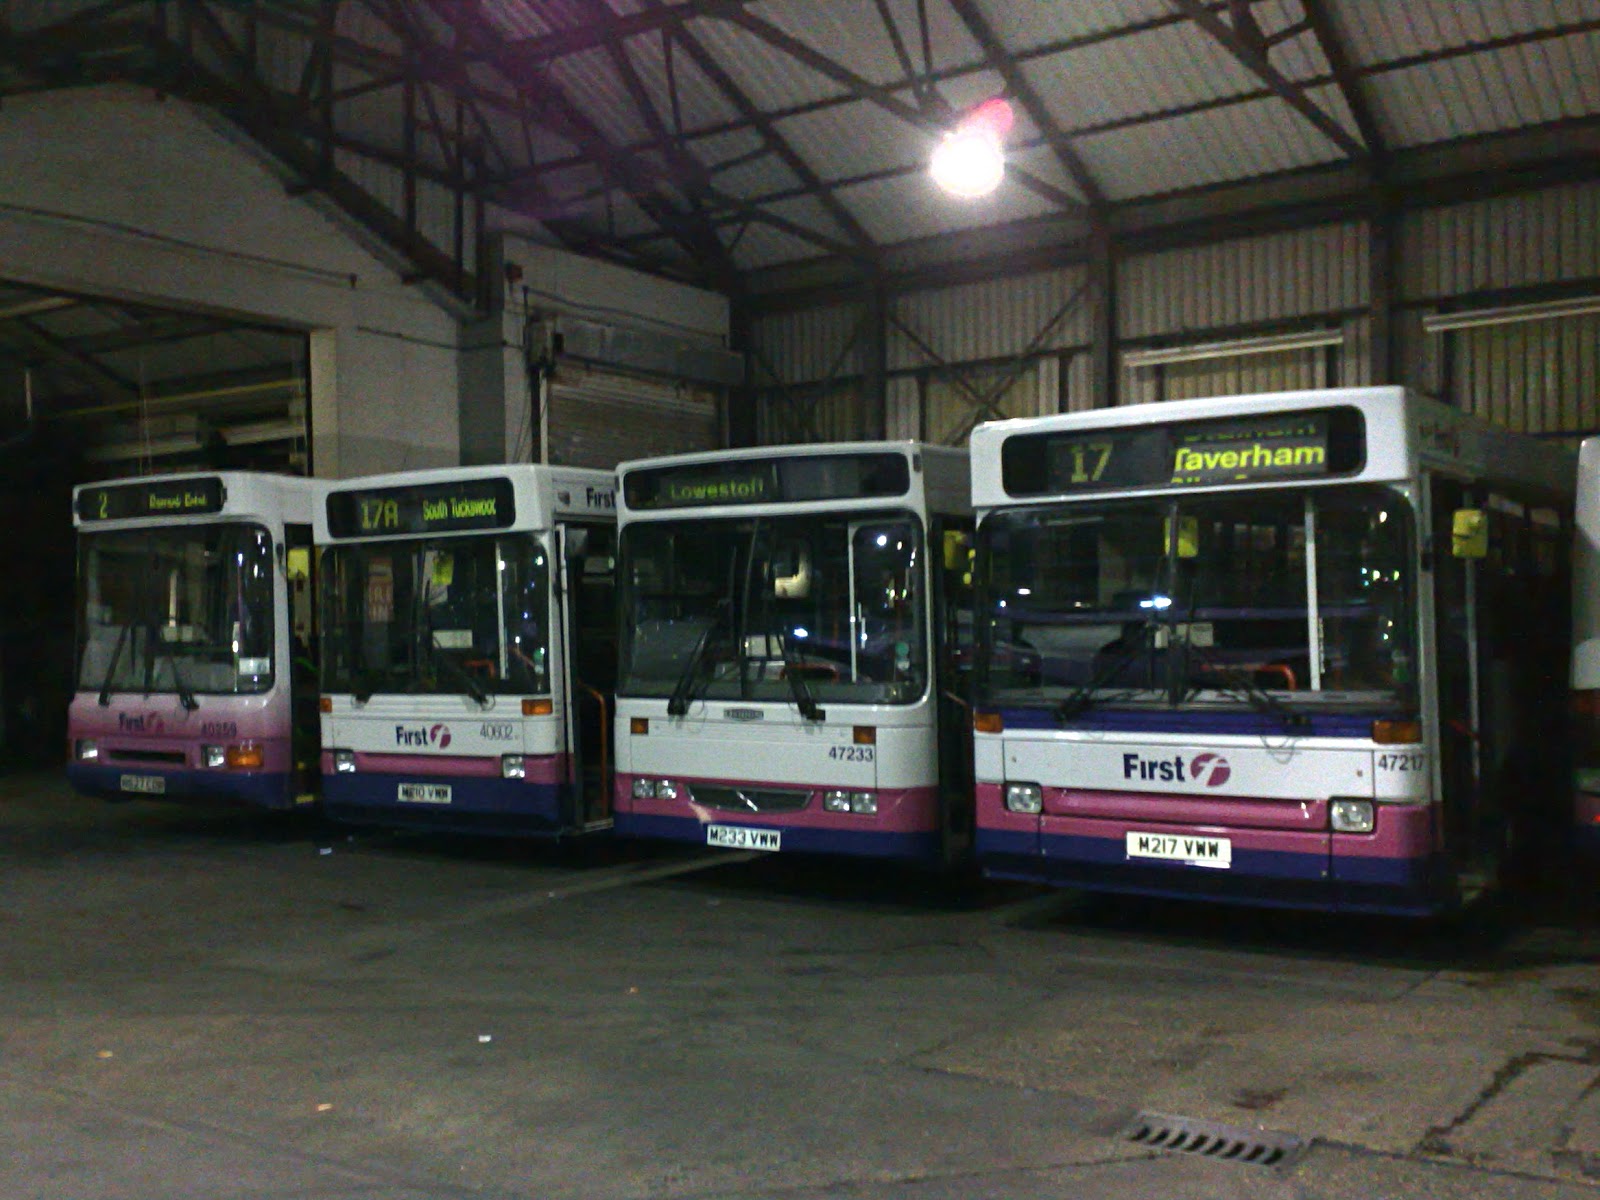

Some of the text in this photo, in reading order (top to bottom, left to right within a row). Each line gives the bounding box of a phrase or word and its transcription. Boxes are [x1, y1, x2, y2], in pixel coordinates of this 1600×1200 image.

[1070, 443, 1114, 483] 17
[1174, 443, 1325, 472] Taverham
[99, 492, 108, 519] 2
[585, 487, 616, 509] First
[395, 725, 429, 746] First
[828, 746, 874, 762] 47233
[1378, 753, 1424, 771] 47217
[1123, 752, 1186, 782] First
[709, 827, 779, 848] M233 VWW
[1138, 836, 1219, 858] M217 VWW
